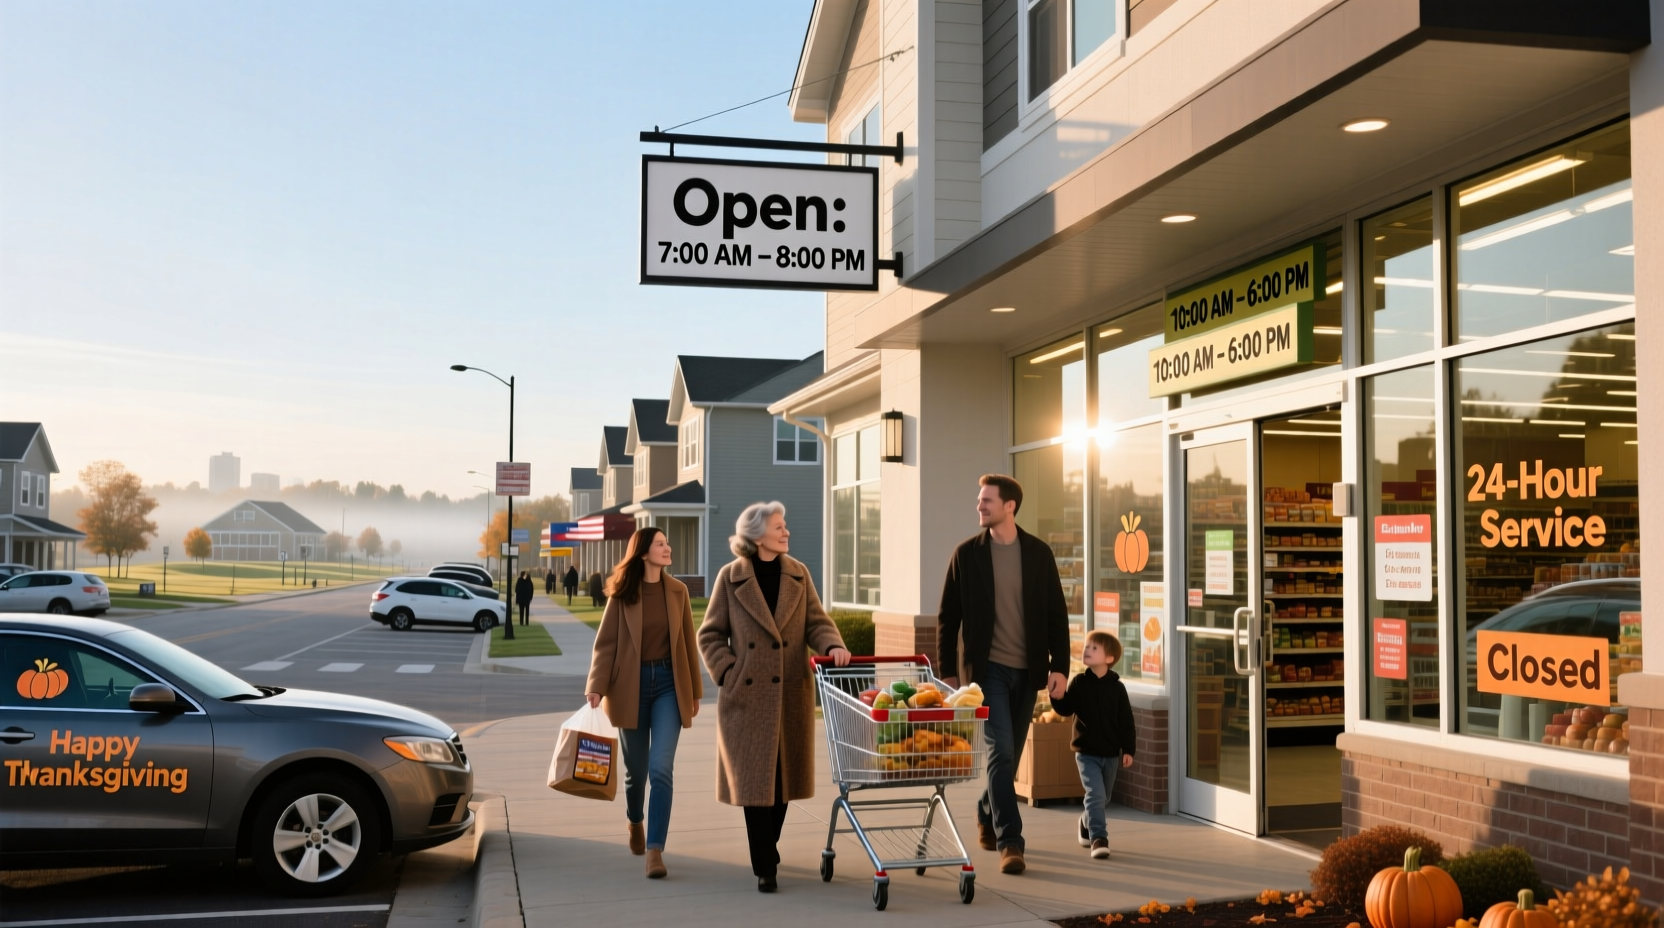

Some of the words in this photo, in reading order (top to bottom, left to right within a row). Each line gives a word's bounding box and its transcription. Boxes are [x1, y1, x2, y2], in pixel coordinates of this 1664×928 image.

[673, 177, 846, 240] Open:
[657, 241, 709, 265] 7:00
[714, 243, 752, 267] AM
[775, 245, 826, 270] 8:00
[831, 247, 865, 272] PM
[1169, 297, 1208, 333] 10:00
[1210, 288, 1234, 321] AM
[1246, 271, 1282, 308] 6:00
[1284, 260, 1309, 295] PM
[1153, 350, 1190, 384] 10:00
[1192, 344, 1214, 374] AM
[1227, 330, 1262, 364] 6:00
[1265, 321, 1291, 355] PM
[1467, 459, 1603, 503] 24-Hour
[1480, 505, 1607, 548] Service
[1487, 642, 1601, 691] Closed
[50, 729, 141, 761] Happy
